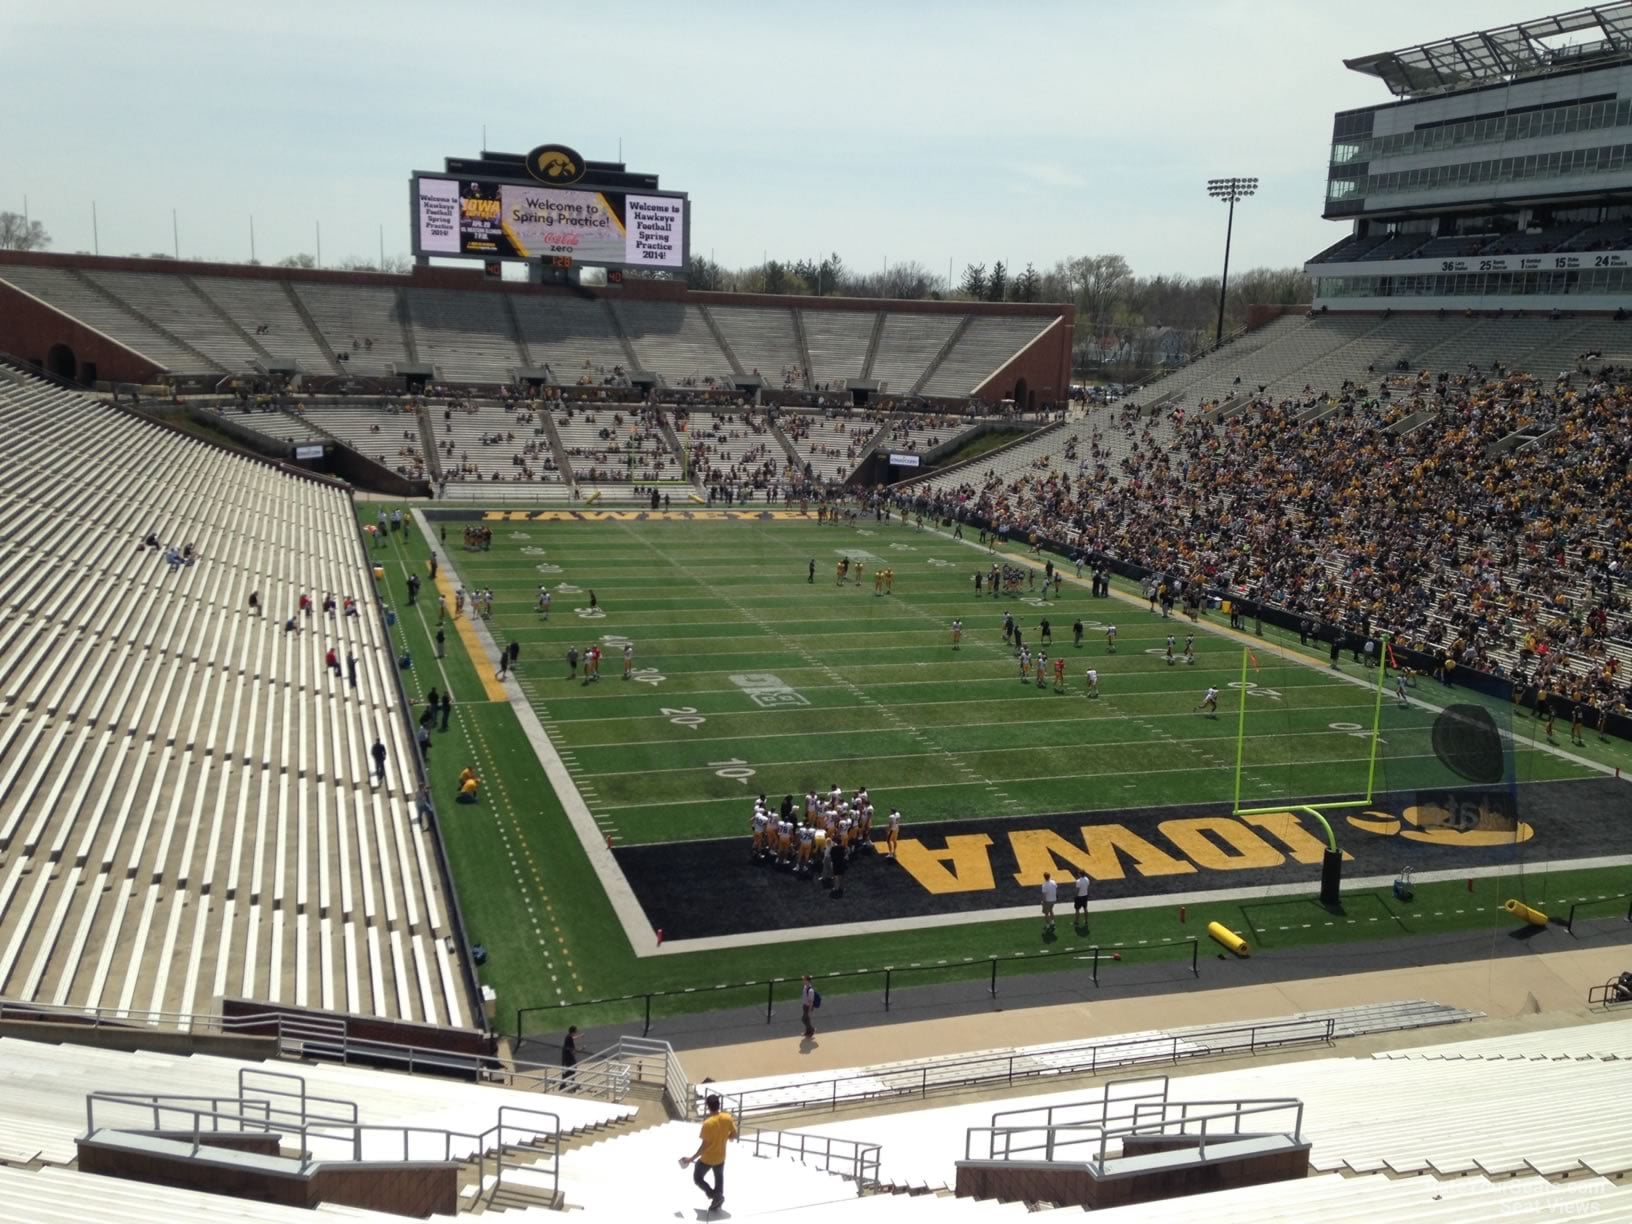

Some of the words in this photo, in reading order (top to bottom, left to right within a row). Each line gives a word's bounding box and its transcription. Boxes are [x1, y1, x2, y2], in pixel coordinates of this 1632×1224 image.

[463, 198, 500, 211] IOWA
[526, 198, 582, 212] Welcome
[586, 203, 599, 213] to
[629, 201, 670, 212] Welcome
[671, 203, 680, 213] to
[512, 210, 553, 226] Spring
[558, 213, 610, 227] Practice!
[634, 212, 674, 223] Hawkeye
[636, 222, 672, 232] Football
[638, 231, 669, 242] Spring
[551, 244, 573, 253] zero
[636, 241, 672, 250] Practice
[642, 250, 666, 259] 2014!
[1442, 261, 1454, 271] 36
[1479, 261, 1492, 271] 25
[1555, 257, 1566, 268] 15
[1595, 256, 1610, 266] 24
[487, 264, 499, 274] 40
[608, 272, 621, 281] 40
[631, 667, 667, 682] 30
[659, 706, 706, 725] 20
[707, 757, 756, 778] 10
[874, 812, 1355, 895] IOWA
